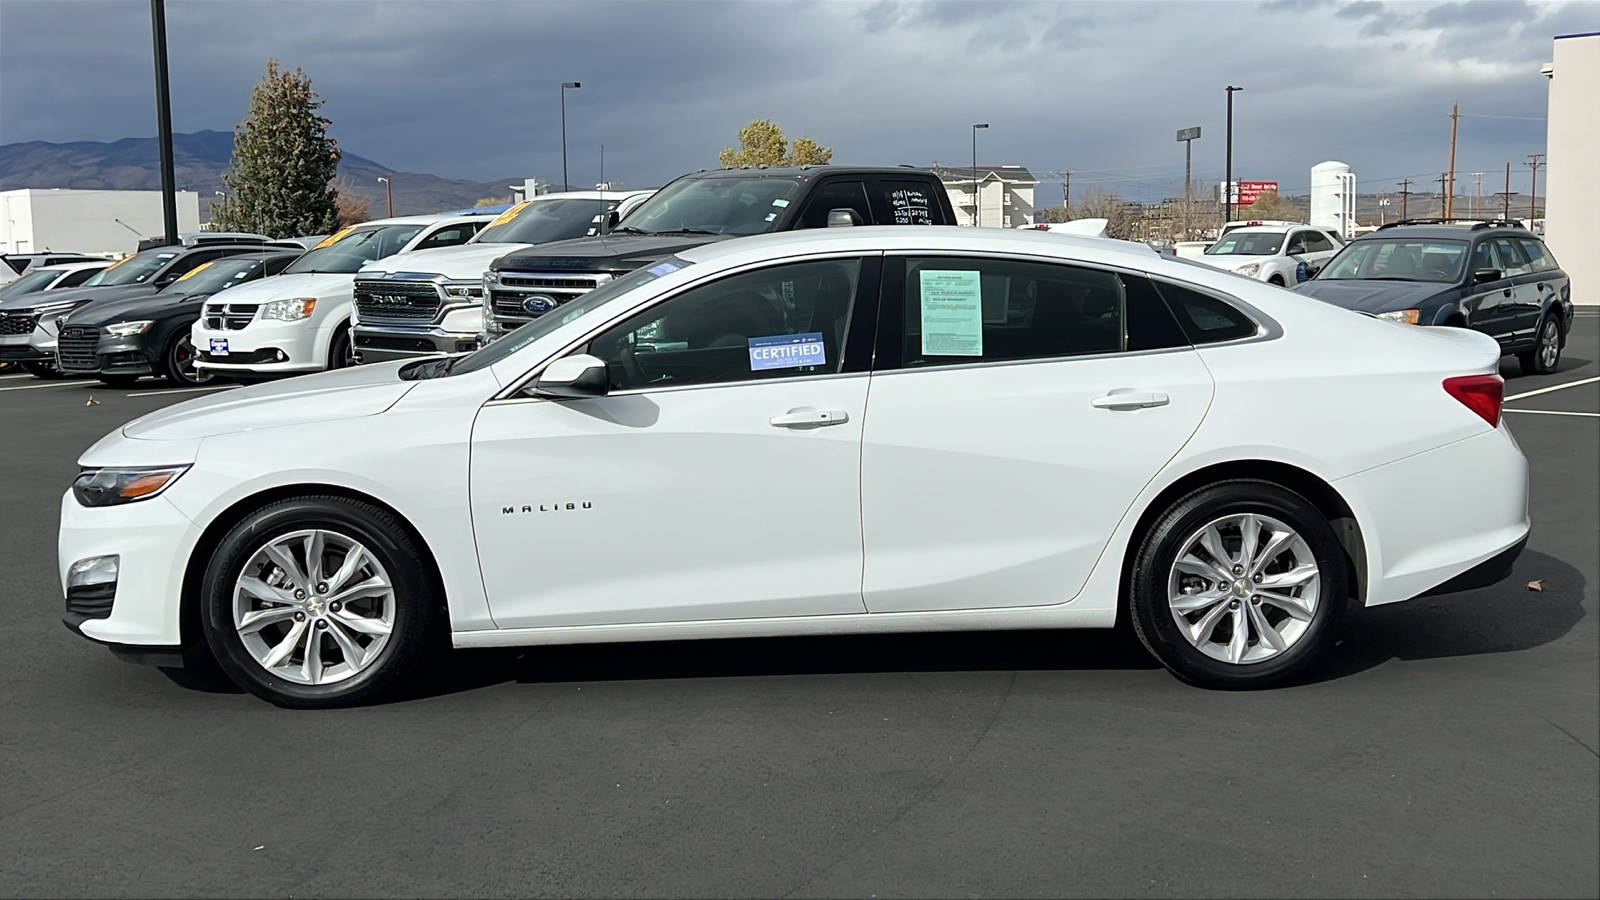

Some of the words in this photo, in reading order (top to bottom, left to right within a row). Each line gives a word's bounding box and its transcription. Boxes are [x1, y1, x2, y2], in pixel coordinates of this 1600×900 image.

[369, 293, 407, 304] RAM
[753, 344, 821, 360] CERTIFIED
[502, 501, 592, 515] MALIBU
